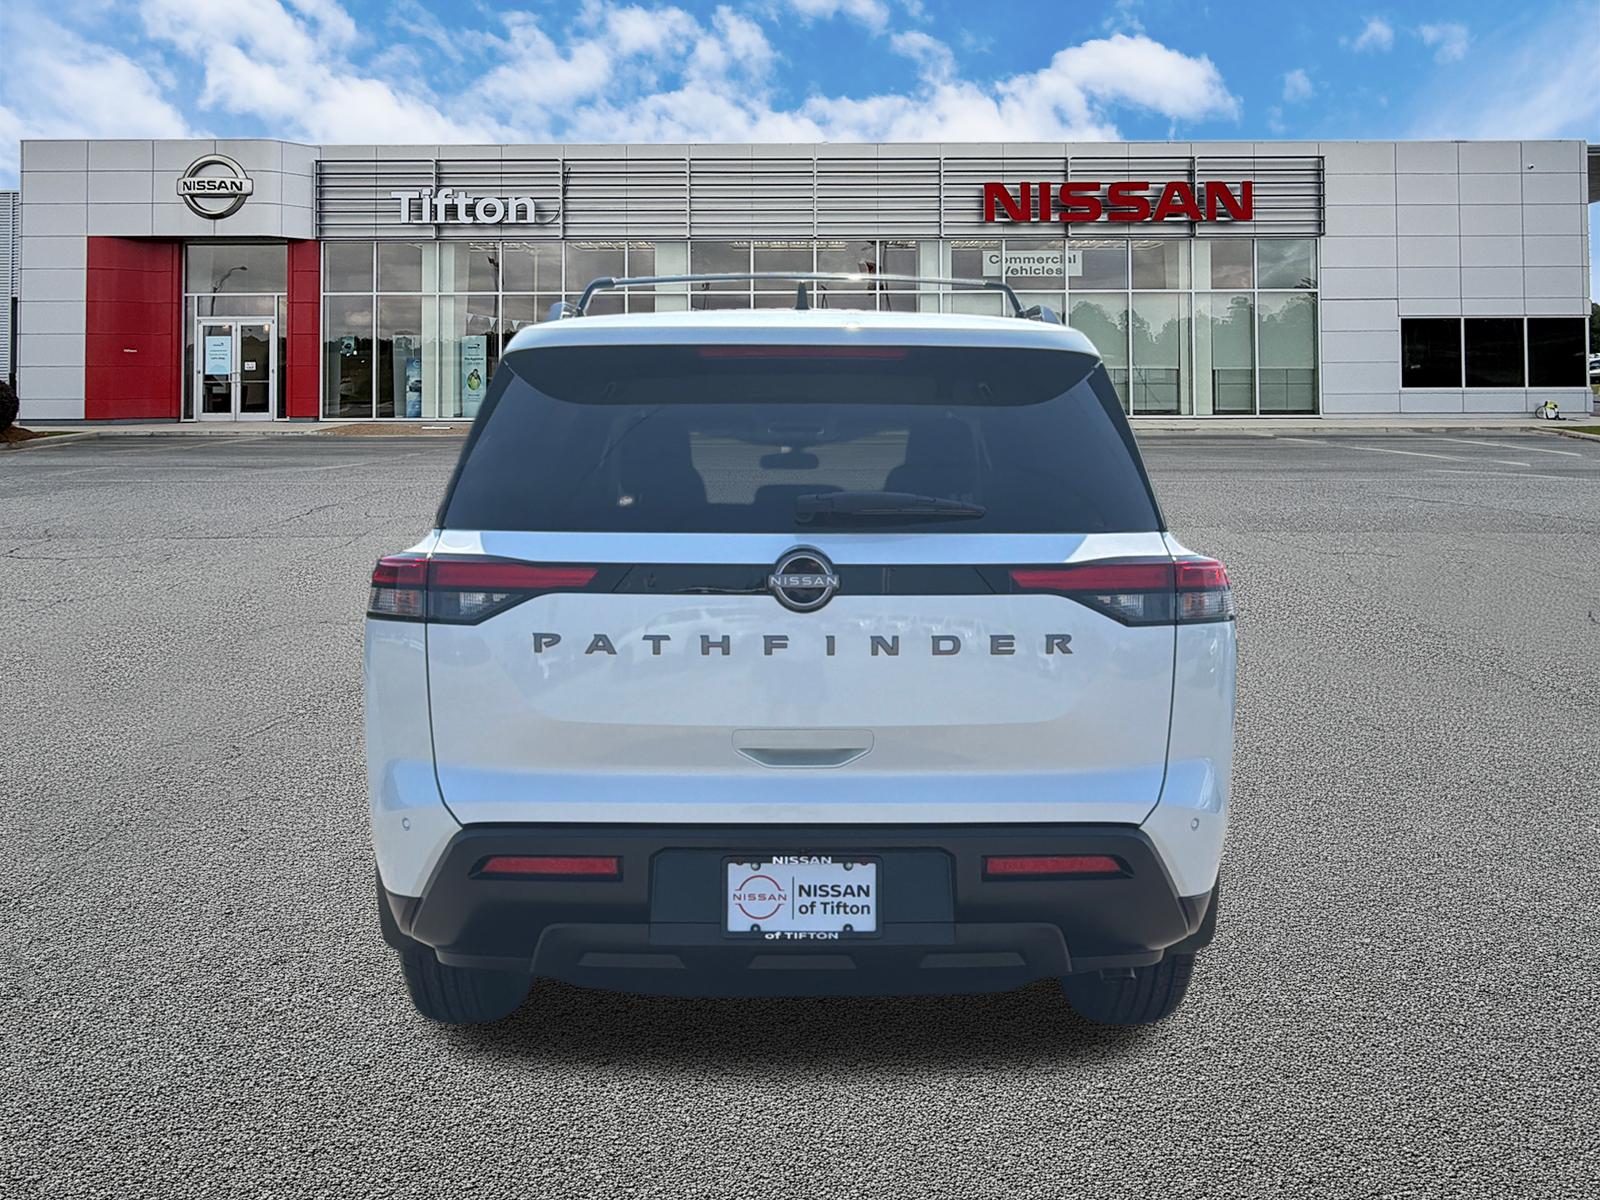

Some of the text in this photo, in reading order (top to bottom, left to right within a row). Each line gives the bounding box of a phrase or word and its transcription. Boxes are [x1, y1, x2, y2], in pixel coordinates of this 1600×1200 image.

[182, 181, 243, 192] NISSAN
[390, 188, 536, 224] Tifton
[983, 181, 1253, 222] NISSAN
[770, 576, 838, 586] NISSAN
[532, 632, 1073, 656] PATHFINDER
[772, 856, 832, 865] NISSAN
[798, 884, 870, 898] NISSAN
[733, 893, 787, 902] NISSAN
[798, 901, 871, 915] of Tifton
[764, 931, 839, 940] of TIFTON
